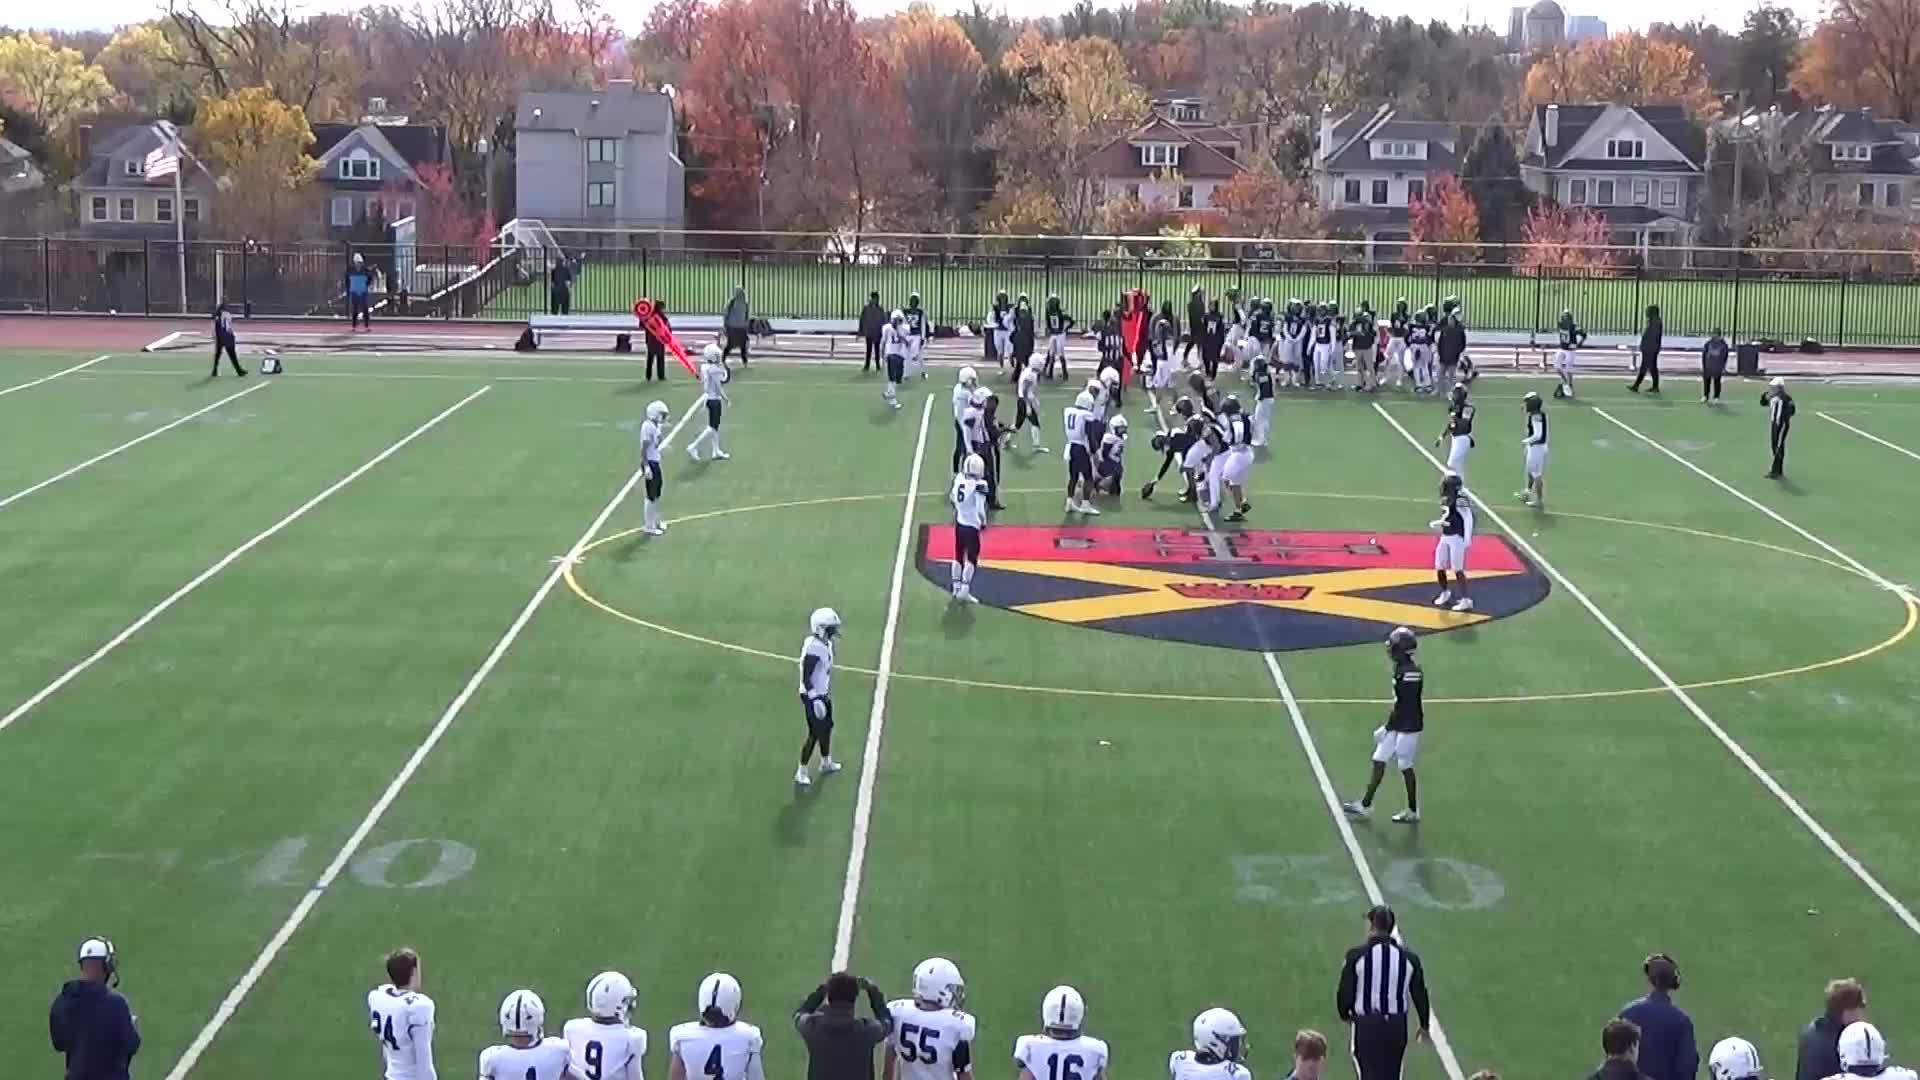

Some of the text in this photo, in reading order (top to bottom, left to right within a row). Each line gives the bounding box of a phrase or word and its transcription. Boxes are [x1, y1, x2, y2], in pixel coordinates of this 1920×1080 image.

[957, 484, 966, 503] 6
[584, 1040, 605, 1079] 9
[900, 1022, 940, 1064] 55
[703, 1044, 725, 1079] 4
[1046, 1053, 1085, 1079] 16
